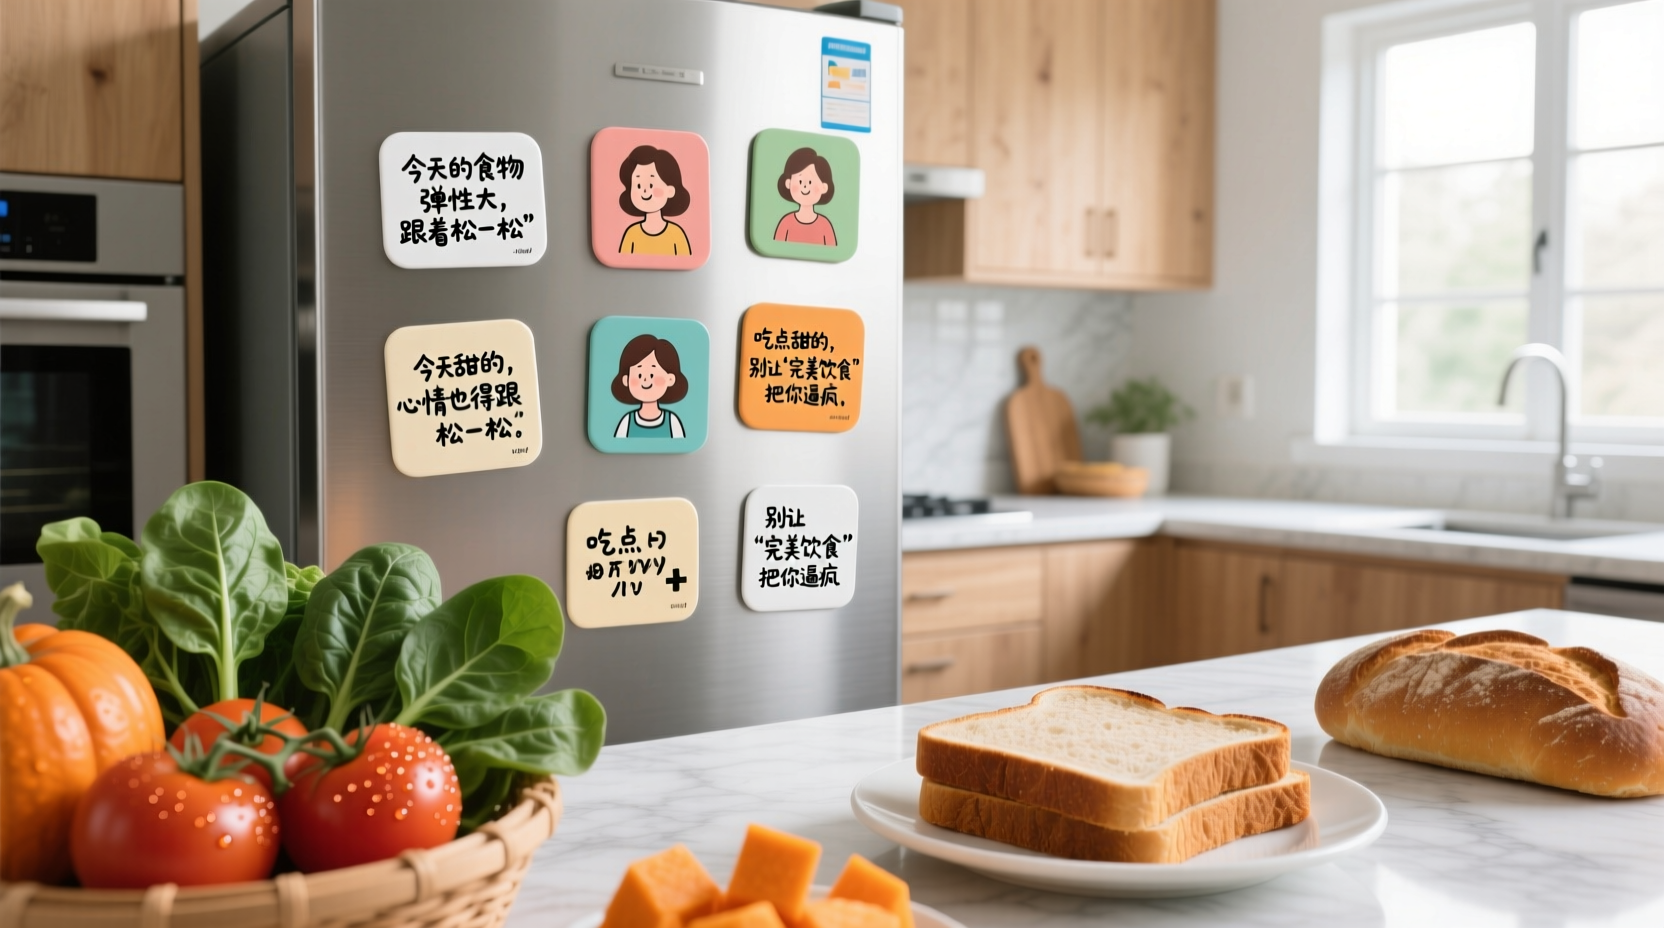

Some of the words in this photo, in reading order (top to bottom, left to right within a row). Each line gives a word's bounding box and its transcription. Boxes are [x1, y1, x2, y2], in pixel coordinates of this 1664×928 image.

[401, 152, 525, 184] 今天的食物
[397, 381, 523, 417] 心情也得跟
[765, 506, 806, 529] 别让
[759, 563, 840, 588] 把你逼疯
